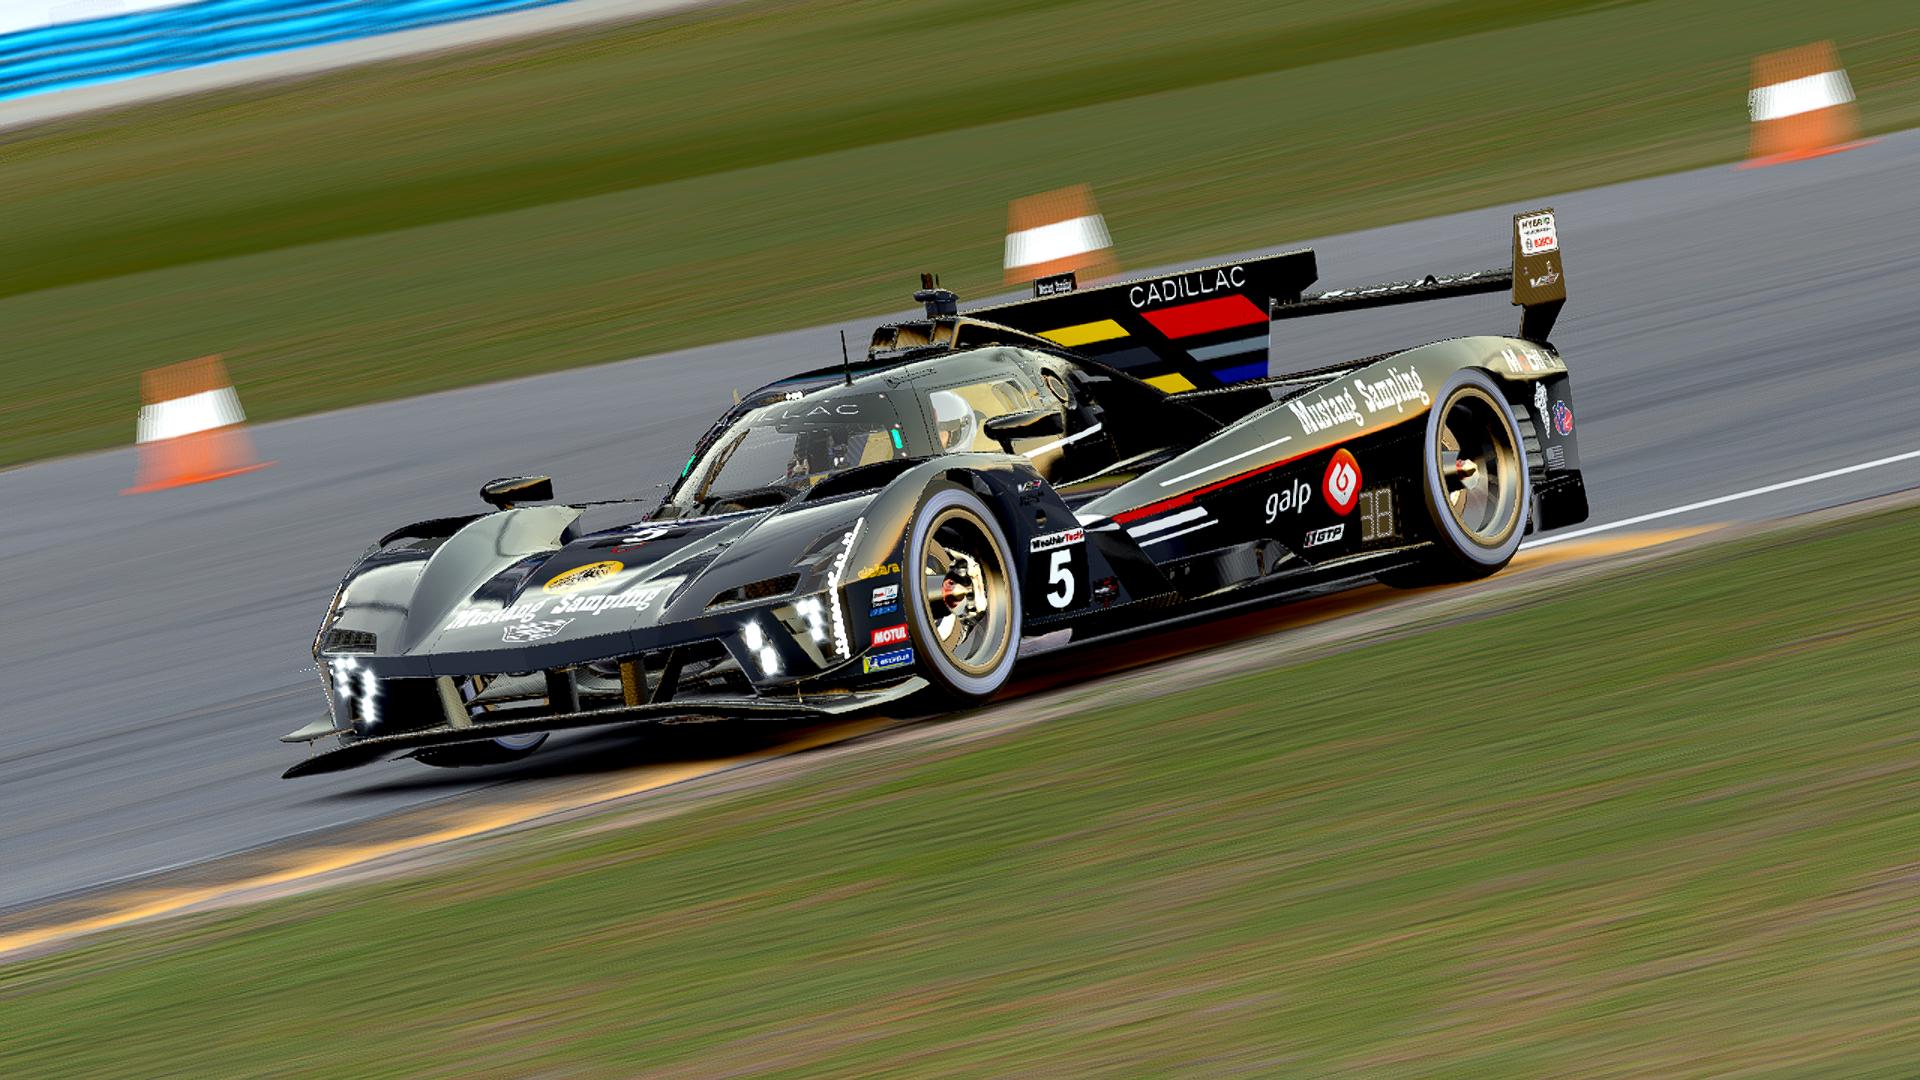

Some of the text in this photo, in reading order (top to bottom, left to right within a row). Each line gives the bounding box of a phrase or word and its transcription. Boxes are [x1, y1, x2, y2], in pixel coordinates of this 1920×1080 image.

[1129, 266, 1246, 309] CADILLAC
[1289, 365, 1431, 435] Mustang Sampling
[1265, 478, 1312, 524] galp
[1315, 526, 1343, 543] GTP
[1046, 549, 1075, 609] 5
[444, 590, 661, 631] Mustang Sampling
[874, 627, 907, 645] MOTUL
